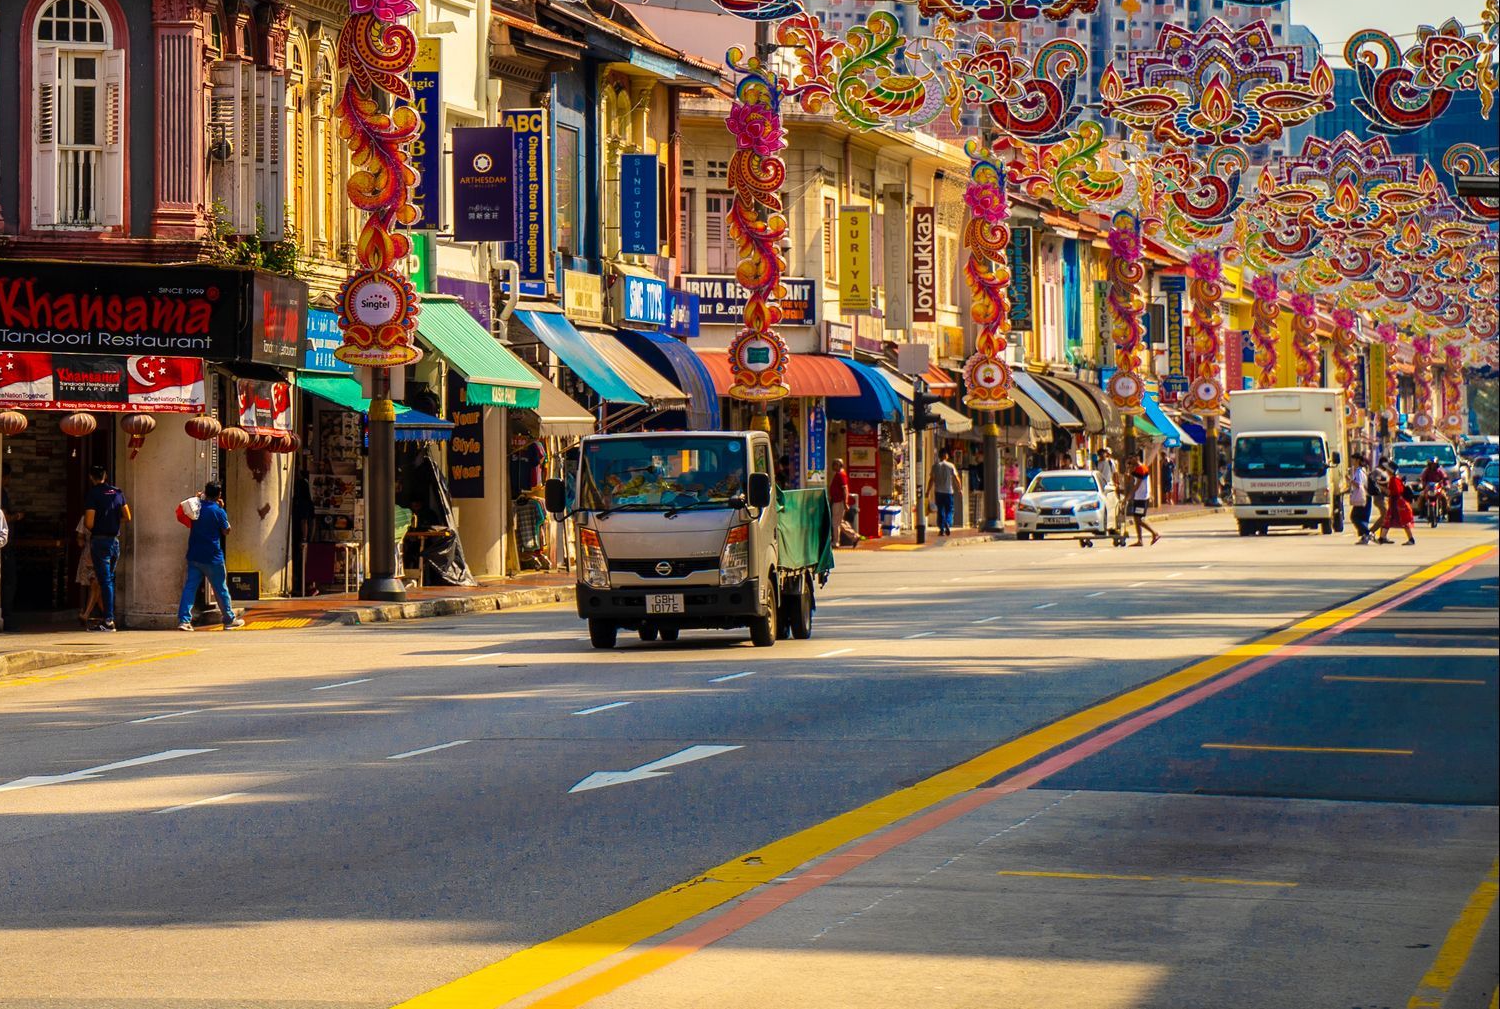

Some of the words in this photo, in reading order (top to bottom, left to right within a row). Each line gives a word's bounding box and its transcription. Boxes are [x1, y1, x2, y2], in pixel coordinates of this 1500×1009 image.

[505, 114, 542, 132] ABC
[527, 136, 539, 182] Cheapest
[529, 183, 539, 210] Store
[527, 223, 539, 273] Singapore
[850, 216, 860, 293] SURIYA
[890, 212, 900, 322] SHEETAL
[687, 282, 723, 299] RIYA
[726, 283, 810, 300] RESANT
[361, 300, 390, 311] Singtel
[0, 329, 91, 345] Tandoori
[98, 332, 213, 349] Restaurant
[57, 368, 122, 382] Khansama
[452, 411, 480, 427] Your
[452, 437, 480, 454] Style
[452, 465, 481, 480] Wear
[655, 594, 675, 603] GBH
[651, 603, 679, 613] 1017E
